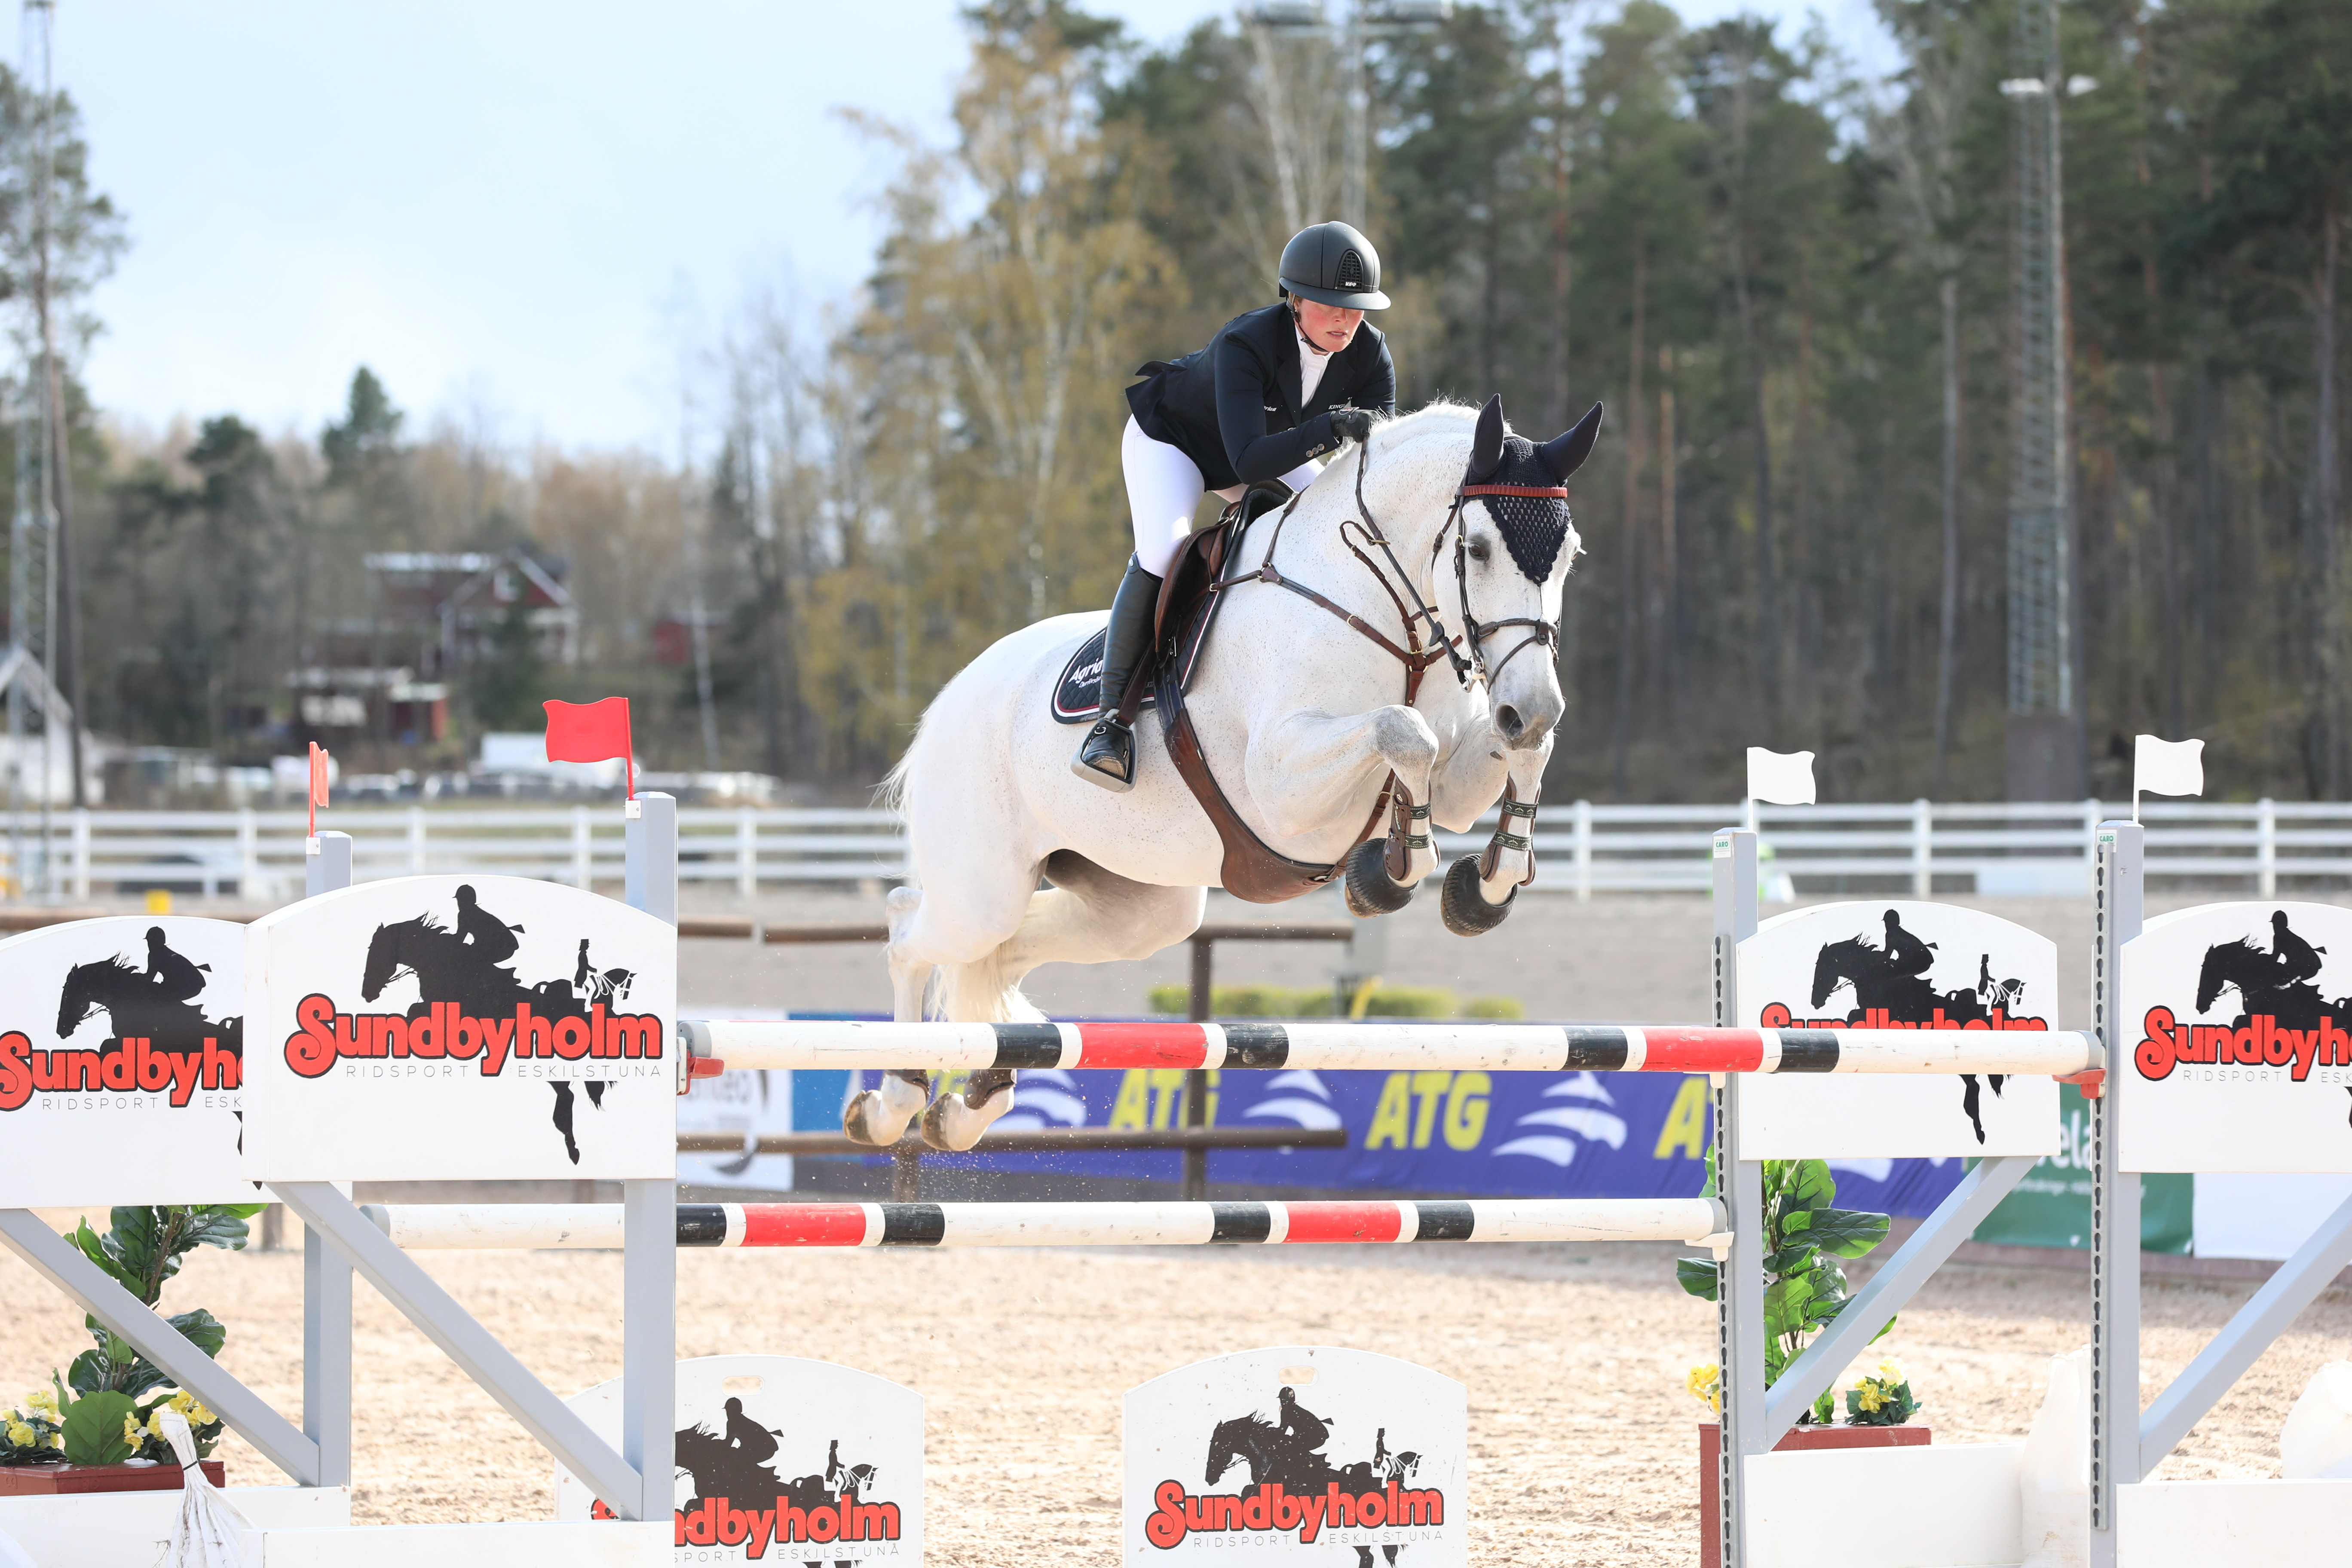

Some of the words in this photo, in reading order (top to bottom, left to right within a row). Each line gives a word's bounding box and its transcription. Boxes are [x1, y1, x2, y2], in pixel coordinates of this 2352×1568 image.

[1068, 657, 1103, 684] Agria
[284, 993, 663, 1078] Sundbyholm
[2134, 1005, 2352, 1082] Sundbyh
[0, 1031, 243, 1112] Sundbyh
[346, 1066, 469, 1078] RIDSPORT
[518, 1065, 661, 1077] ESKILSTUNA
[2183, 1070, 2282, 1082] RIDSPORT
[43, 1097, 158, 1110] RIDSPORT
[205, 1096, 242, 1108] ESK
[1364, 1071, 1492, 1152] ATG
[1145, 1479, 1444, 1550] Sundbyholm
[778, 1546, 899, 1560] ESKILSTUNA
[1194, 1535, 1290, 1548] RIDSPORT
[1329, 1531, 1443, 1544] ESKILSTUNA
